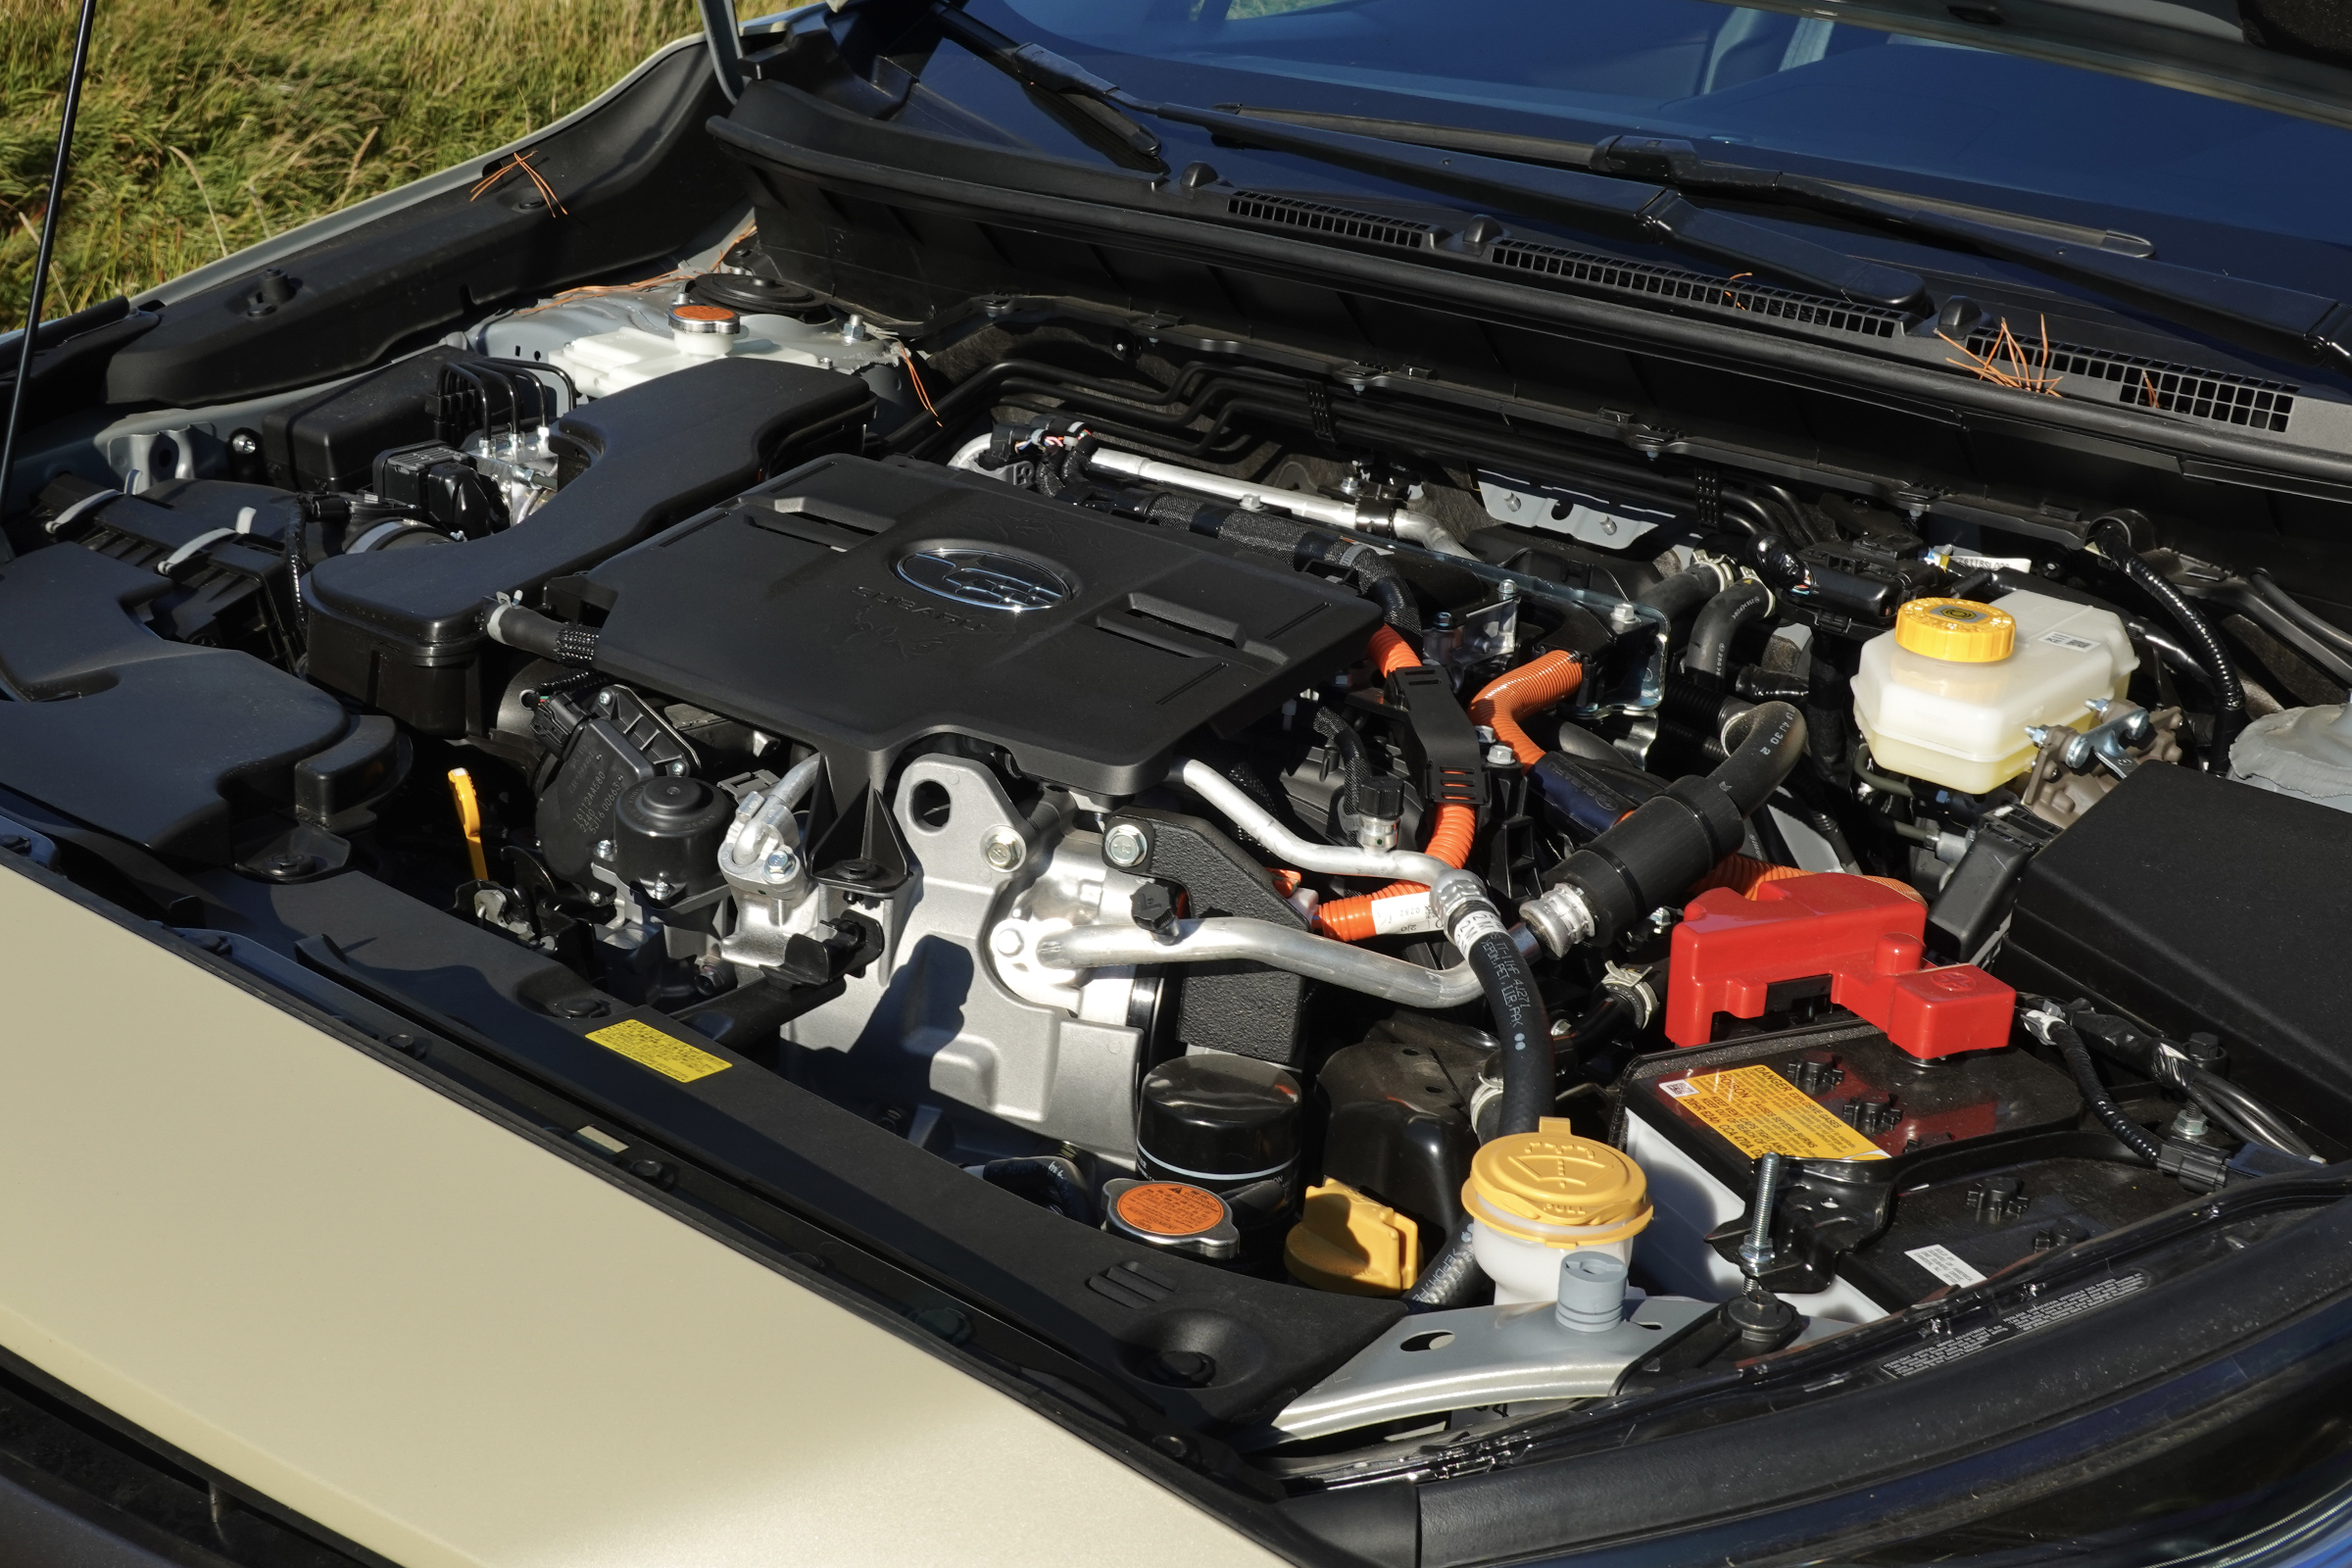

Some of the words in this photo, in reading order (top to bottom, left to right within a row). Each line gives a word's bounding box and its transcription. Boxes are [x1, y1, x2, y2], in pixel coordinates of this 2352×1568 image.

[851, 586, 986, 631] SUBARU
[1759, 745, 1771, 756] 2
[572, 770, 606, 825] 16112AA580
[579, 808, 596, 833] 2440
[1682, 1098, 1707, 1111] 20HR
[1716, 1123, 1740, 1136] CCA
[1699, 1098, 1720, 1108] KEEP
[1714, 1108, 1732, 1118] OUT
[1734, 1123, 1758, 1139] REACH
[1714, 1074, 1751, 1098] POISON
[1748, 1100, 1777, 1117] CAUSES
[1771, 1116, 1798, 1133] SEVERE
[1793, 1132, 1818, 1148] BURNS
[1753, 1066, 1793, 1092] DANGER
[1788, 1092, 1823, 1114] EXPLOSIVE
[1818, 1113, 1842, 1128] GASES
[1709, 1096, 1730, 1106] KEEP
[1724, 1106, 1744, 1118] VENT
[1738, 1117, 1759, 1129] CAPS
[1753, 1128, 1776, 1142] TIGHT
[1769, 1141, 1788, 1152] AND
[1543, 1203, 1587, 1215] PULL
